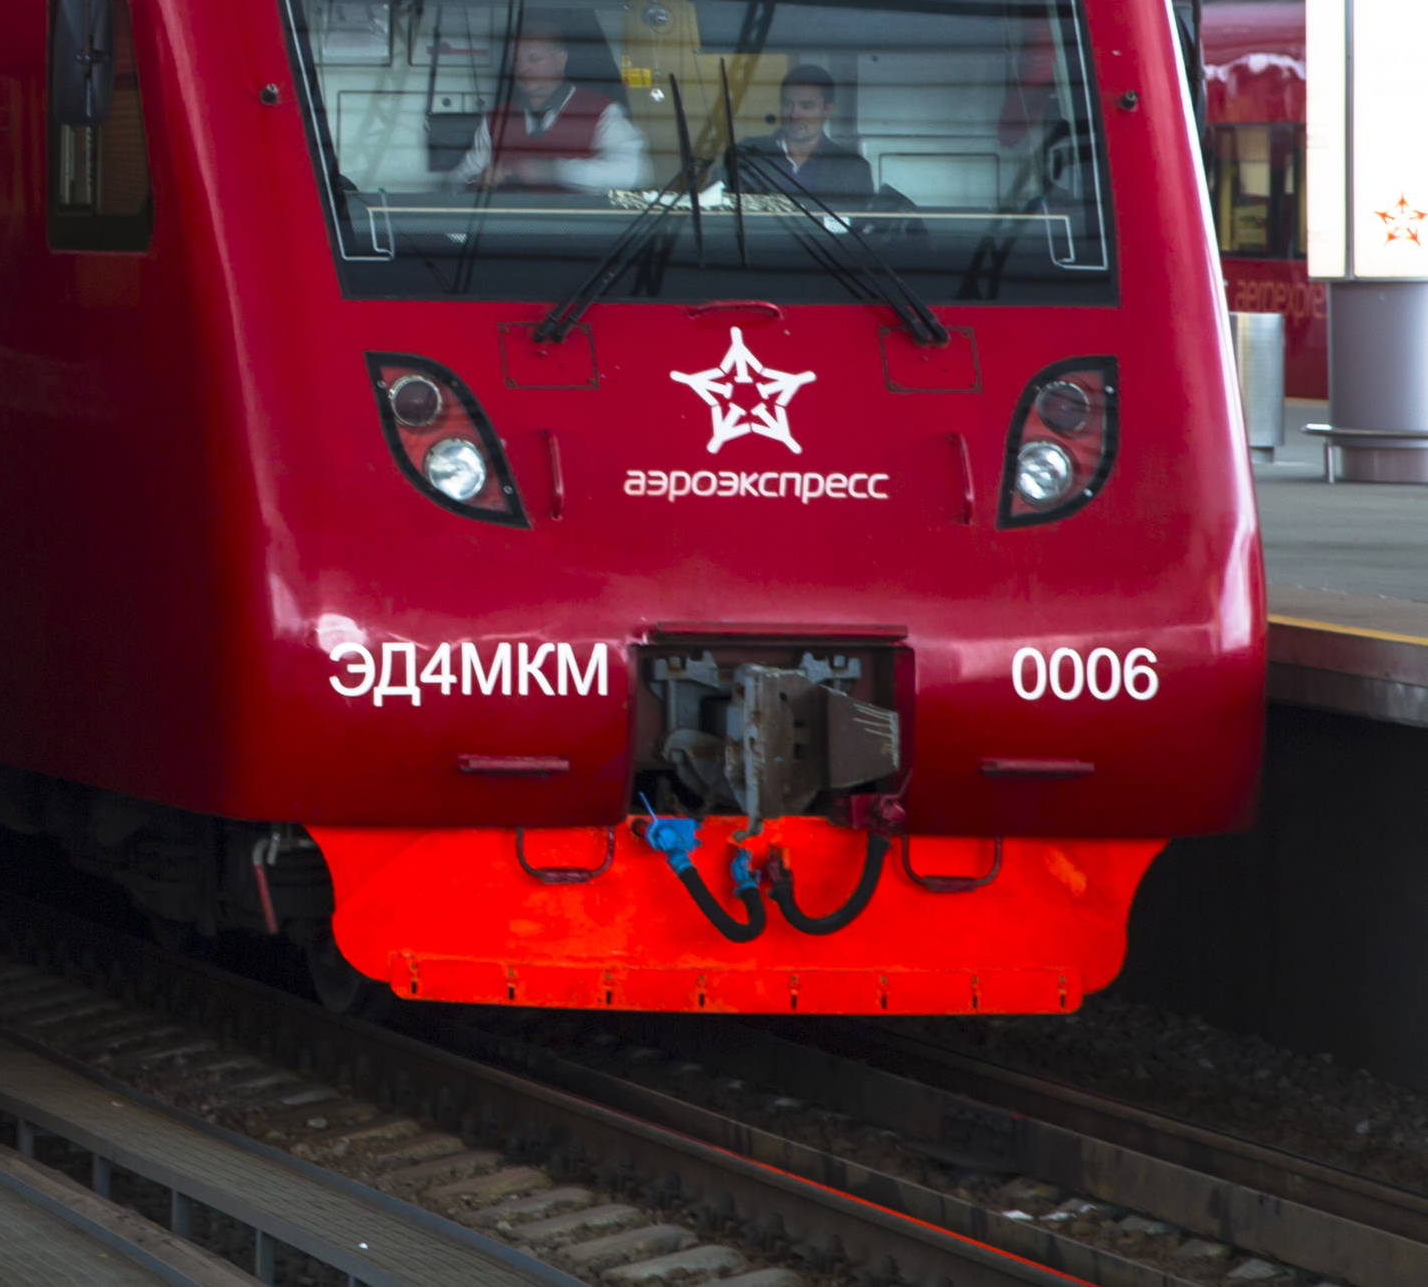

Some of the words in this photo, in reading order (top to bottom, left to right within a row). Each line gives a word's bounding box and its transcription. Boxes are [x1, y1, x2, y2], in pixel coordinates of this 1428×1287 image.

[1234, 280, 1327, 326] aeroexpre
[623, 469, 890, 505] аэроэкспресс
[328, 641, 608, 708] ЭД4МКМ
[1011, 646, 1159, 701] 0006
